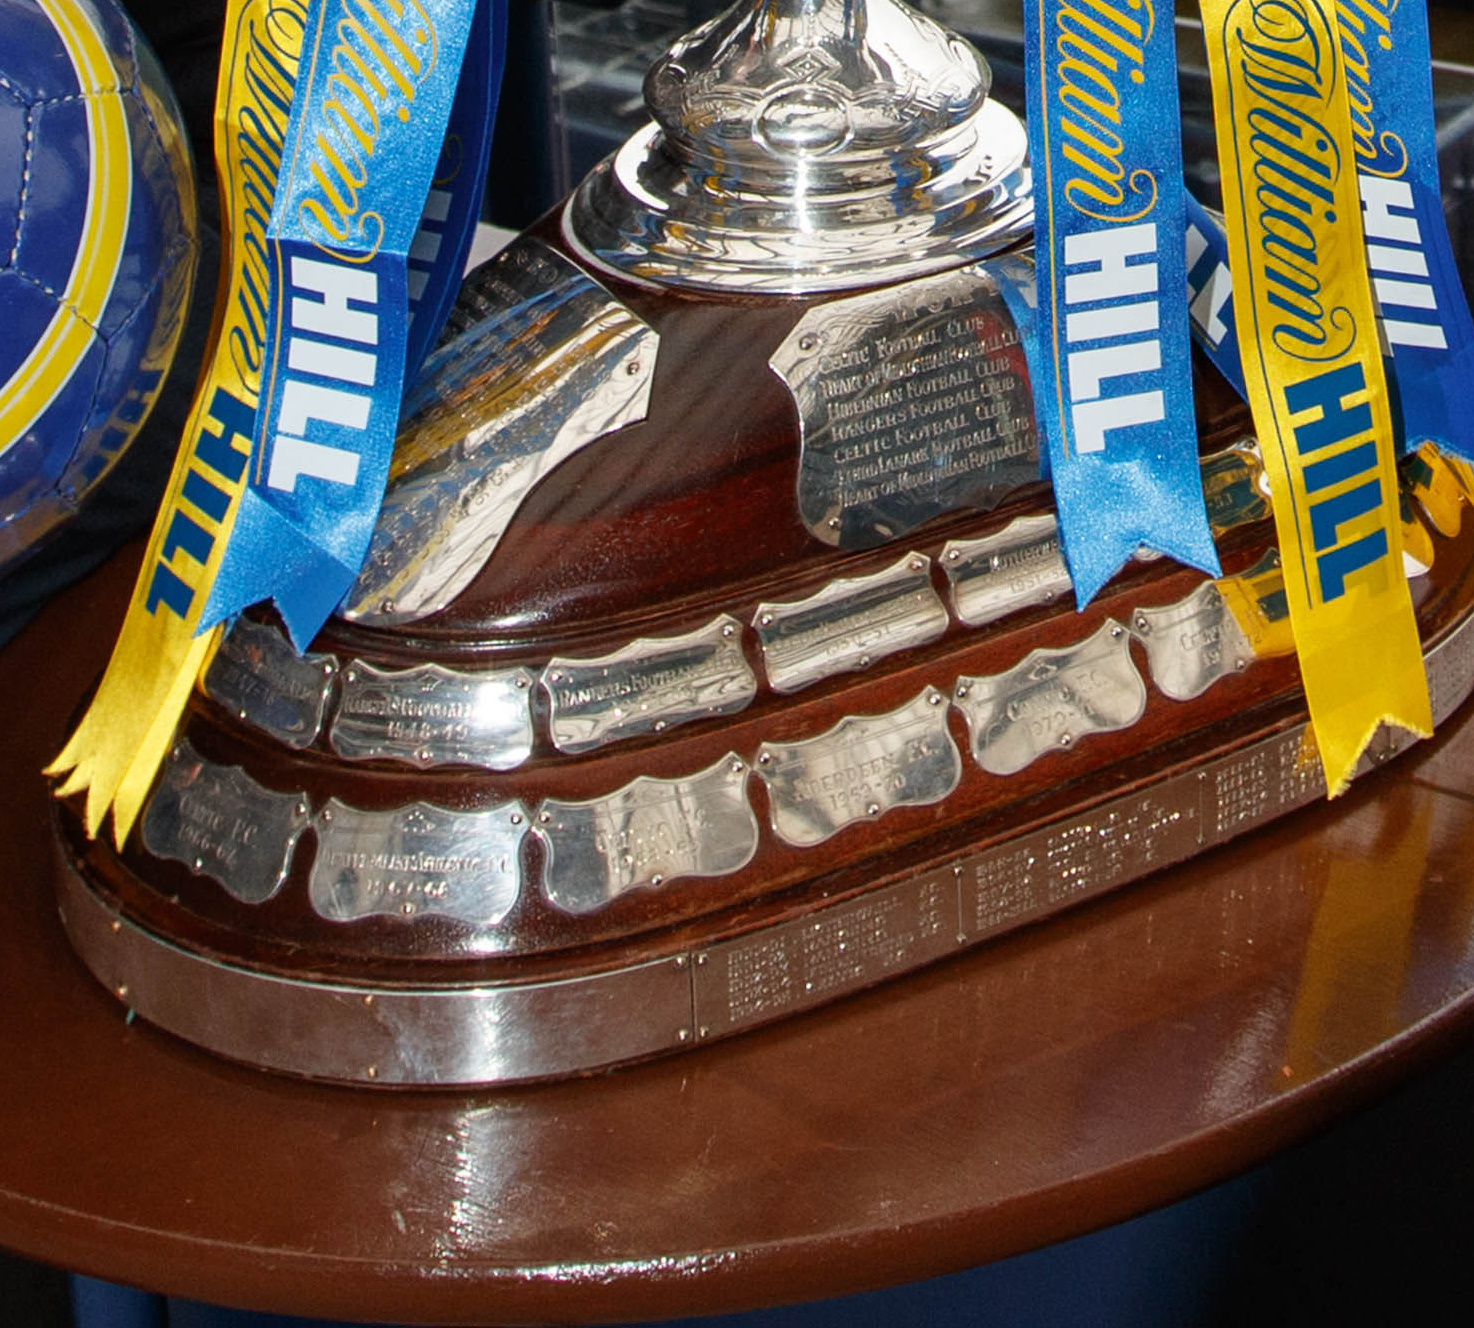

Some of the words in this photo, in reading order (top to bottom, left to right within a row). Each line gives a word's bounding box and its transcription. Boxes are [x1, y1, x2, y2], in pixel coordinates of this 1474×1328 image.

[1355, 173, 1448, 351] HILL
[267, 255, 378, 493] HILL
[946, 316, 986, 338] CLUB
[1064, 222, 1166, 455] HILL
[825, 387, 904, 422] HIBERNIAN
[906, 370, 973, 400] FOOTBALL
[975, 356, 1011, 379] CLUB
[830, 408, 908, 443] RANGERS
[910, 389, 982, 420] FOOTBALL
[834, 435, 891, 465] CELTIC
[895, 413, 970, 447] FOOTBALL
[931, 427, 997, 459] FOOTBALL
[146, 385, 254, 620] HILL
[1283, 362, 1395, 602] HILL
